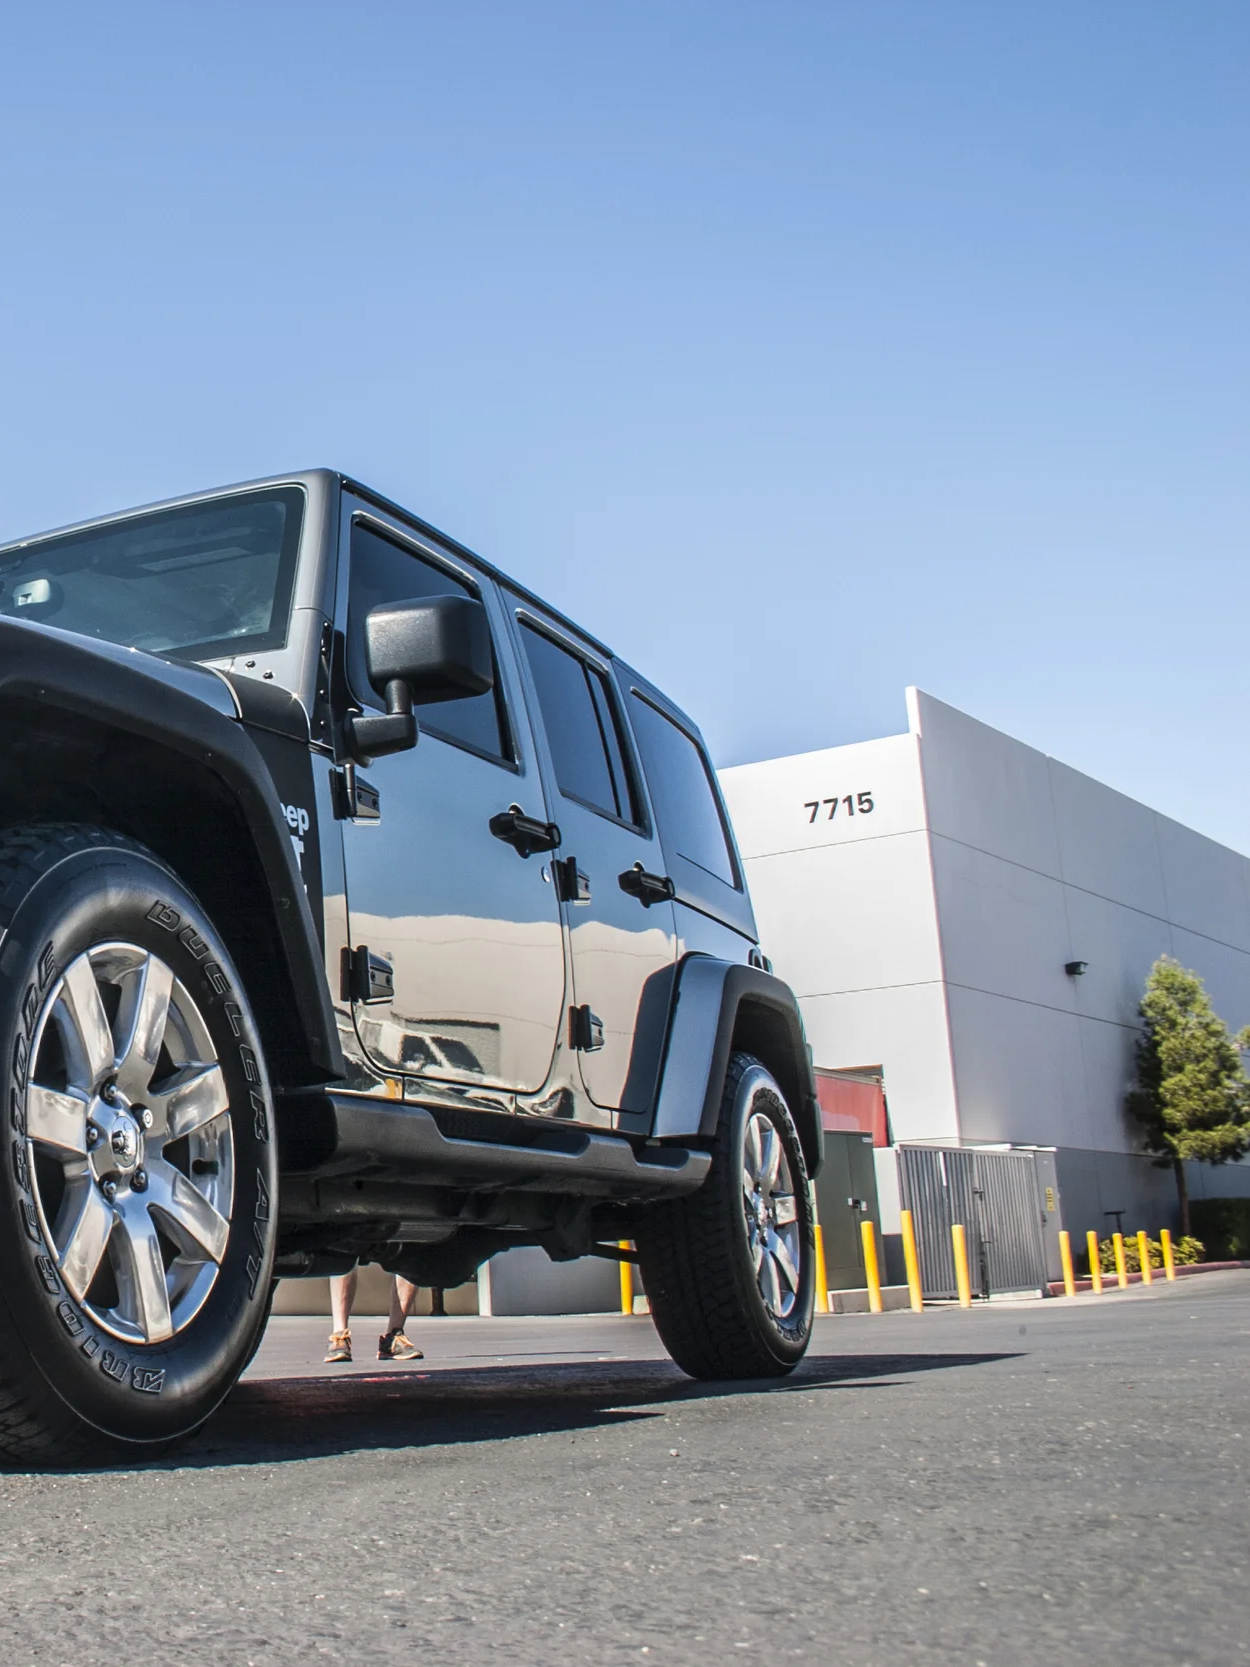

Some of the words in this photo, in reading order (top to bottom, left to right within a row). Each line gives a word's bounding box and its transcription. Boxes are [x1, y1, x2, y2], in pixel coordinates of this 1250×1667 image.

[280, 802, 310, 836] ep
[803, 790, 874, 824] 7715
[9, 939, 166, 1394] BRIDGESTONE
[147, 899, 270, 1144] DUELER
[245, 1167, 271, 1301] A/T
